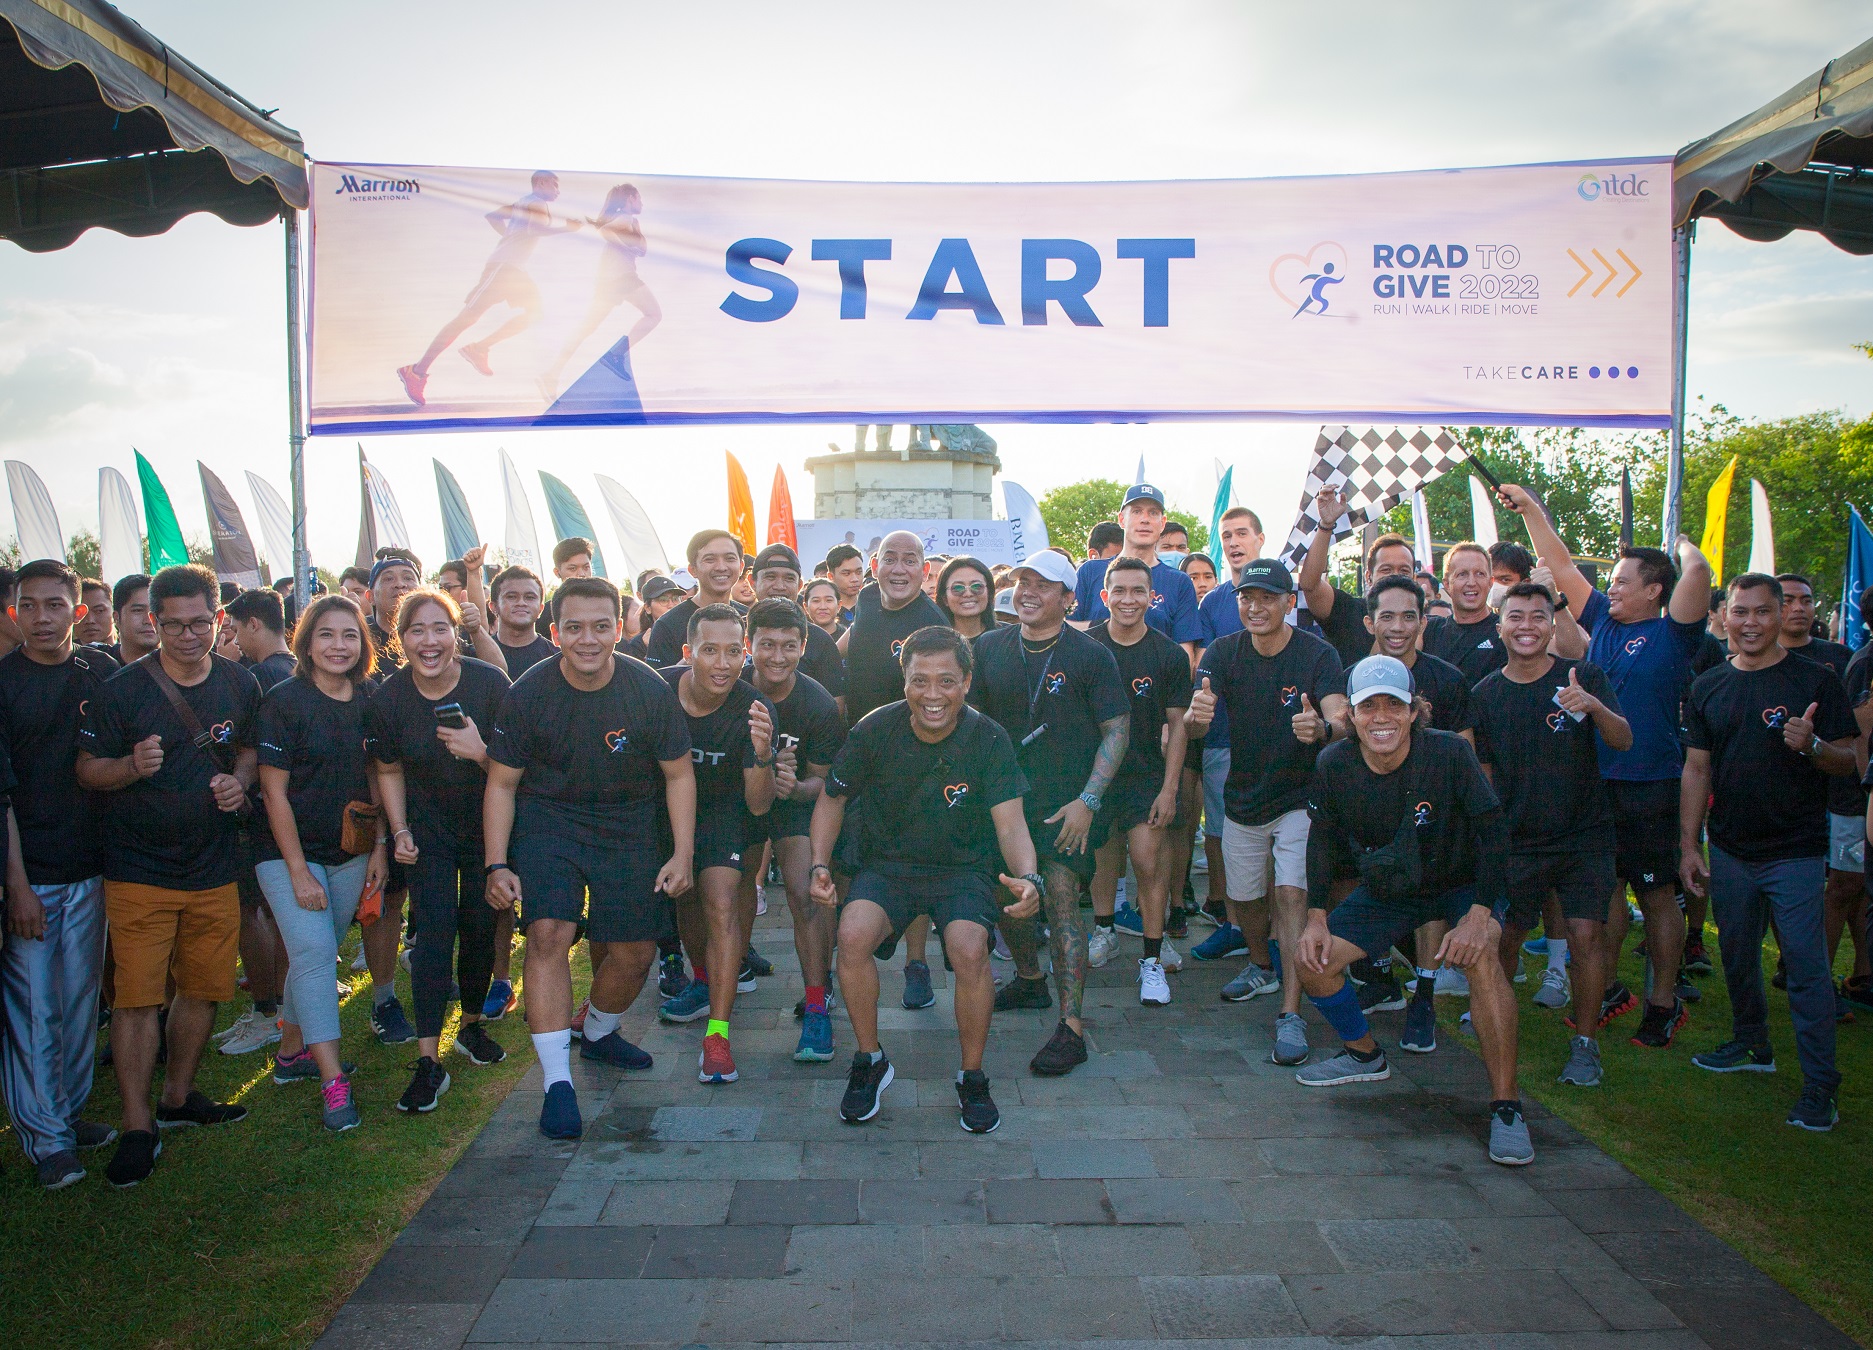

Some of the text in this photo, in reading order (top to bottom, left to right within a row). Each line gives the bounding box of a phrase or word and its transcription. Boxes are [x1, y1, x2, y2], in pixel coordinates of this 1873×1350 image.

[335, 174, 420, 195] Marriott
[1601, 173, 1649, 196] itdc
[1373, 243, 1521, 270] ROAD TO
[719, 237, 1196, 328] START
[1372, 273, 1539, 300] GIVE 2022
[1373, 304, 1538, 315] RUN WALK RIDE MOVE
[947, 538, 1004, 548] GIVE 2022
[948, 528, 998, 538] ROAD TO
[1361, 663, 1398, 678] Callaway
